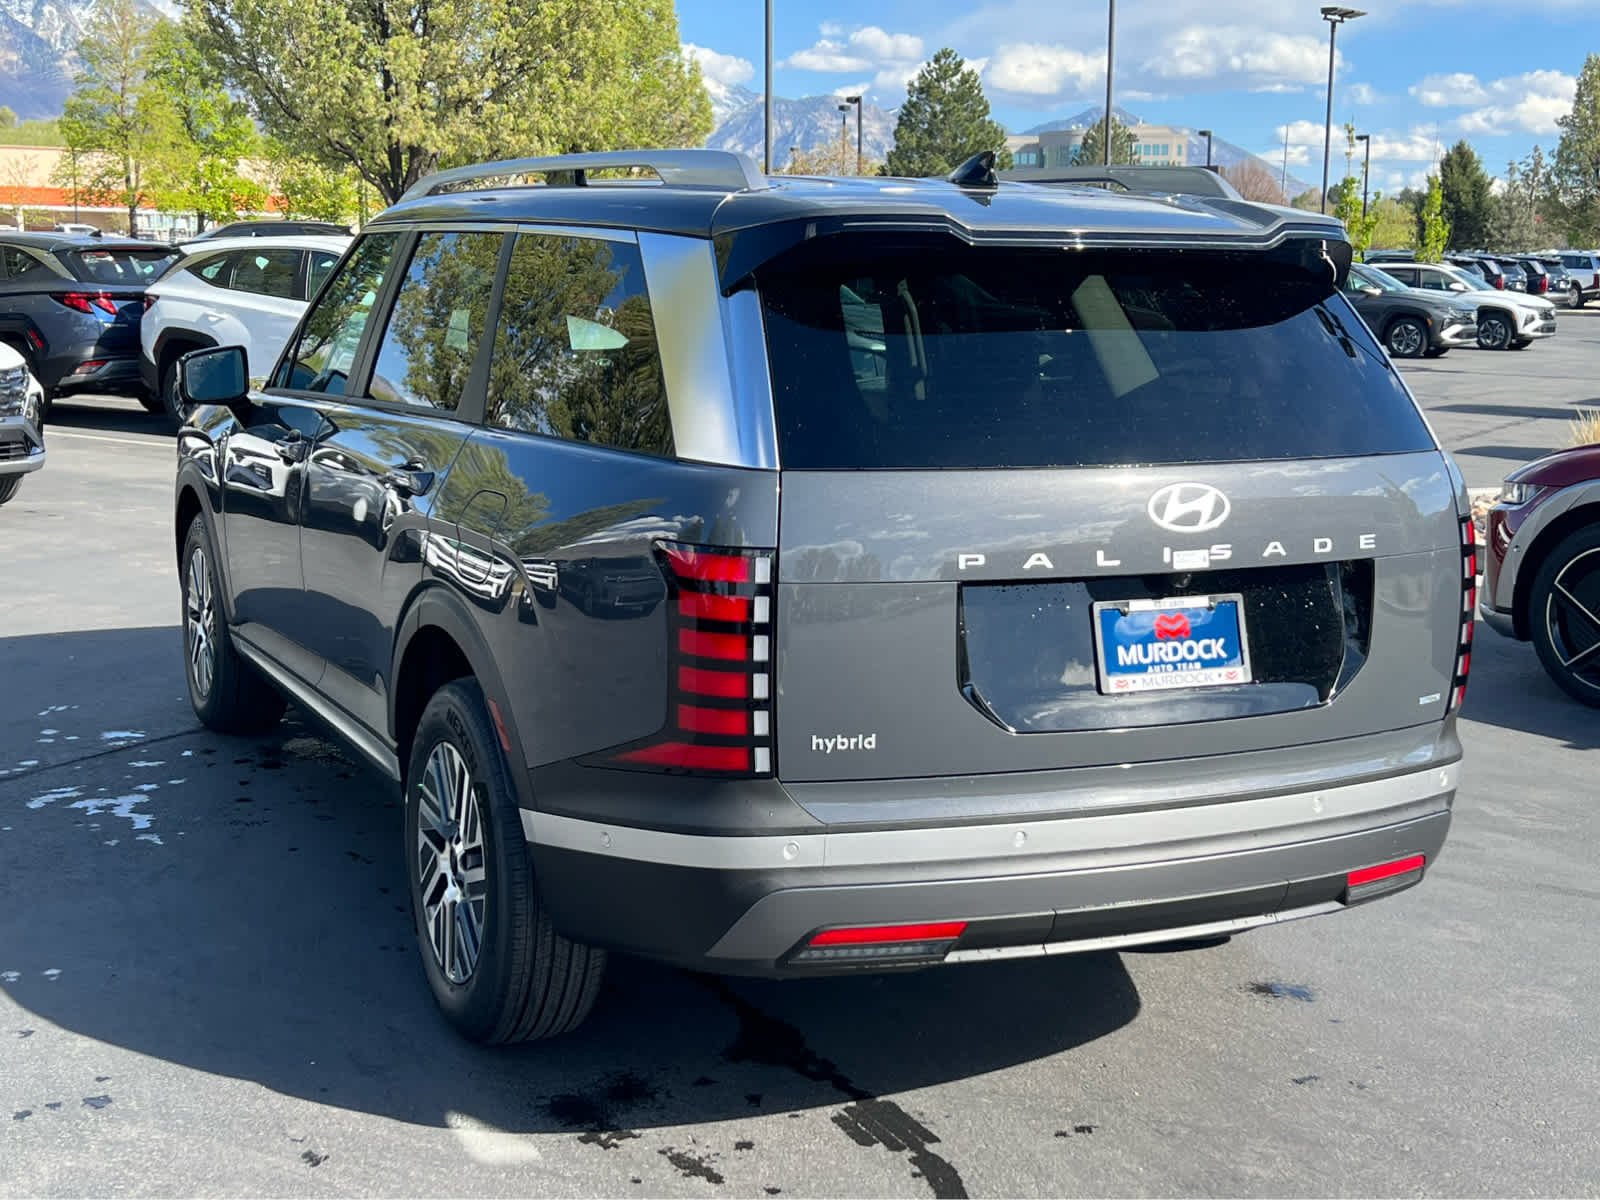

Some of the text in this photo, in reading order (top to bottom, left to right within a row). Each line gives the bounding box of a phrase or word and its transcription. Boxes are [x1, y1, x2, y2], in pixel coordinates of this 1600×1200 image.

[958, 534, 1376, 569] PALISADE
[1117, 638, 1227, 666] MURDOCK
[1147, 661, 1202, 673] AUTO TEAM
[1141, 670, 1214, 687] MURDOCK
[812, 733, 876, 754] hybrid
